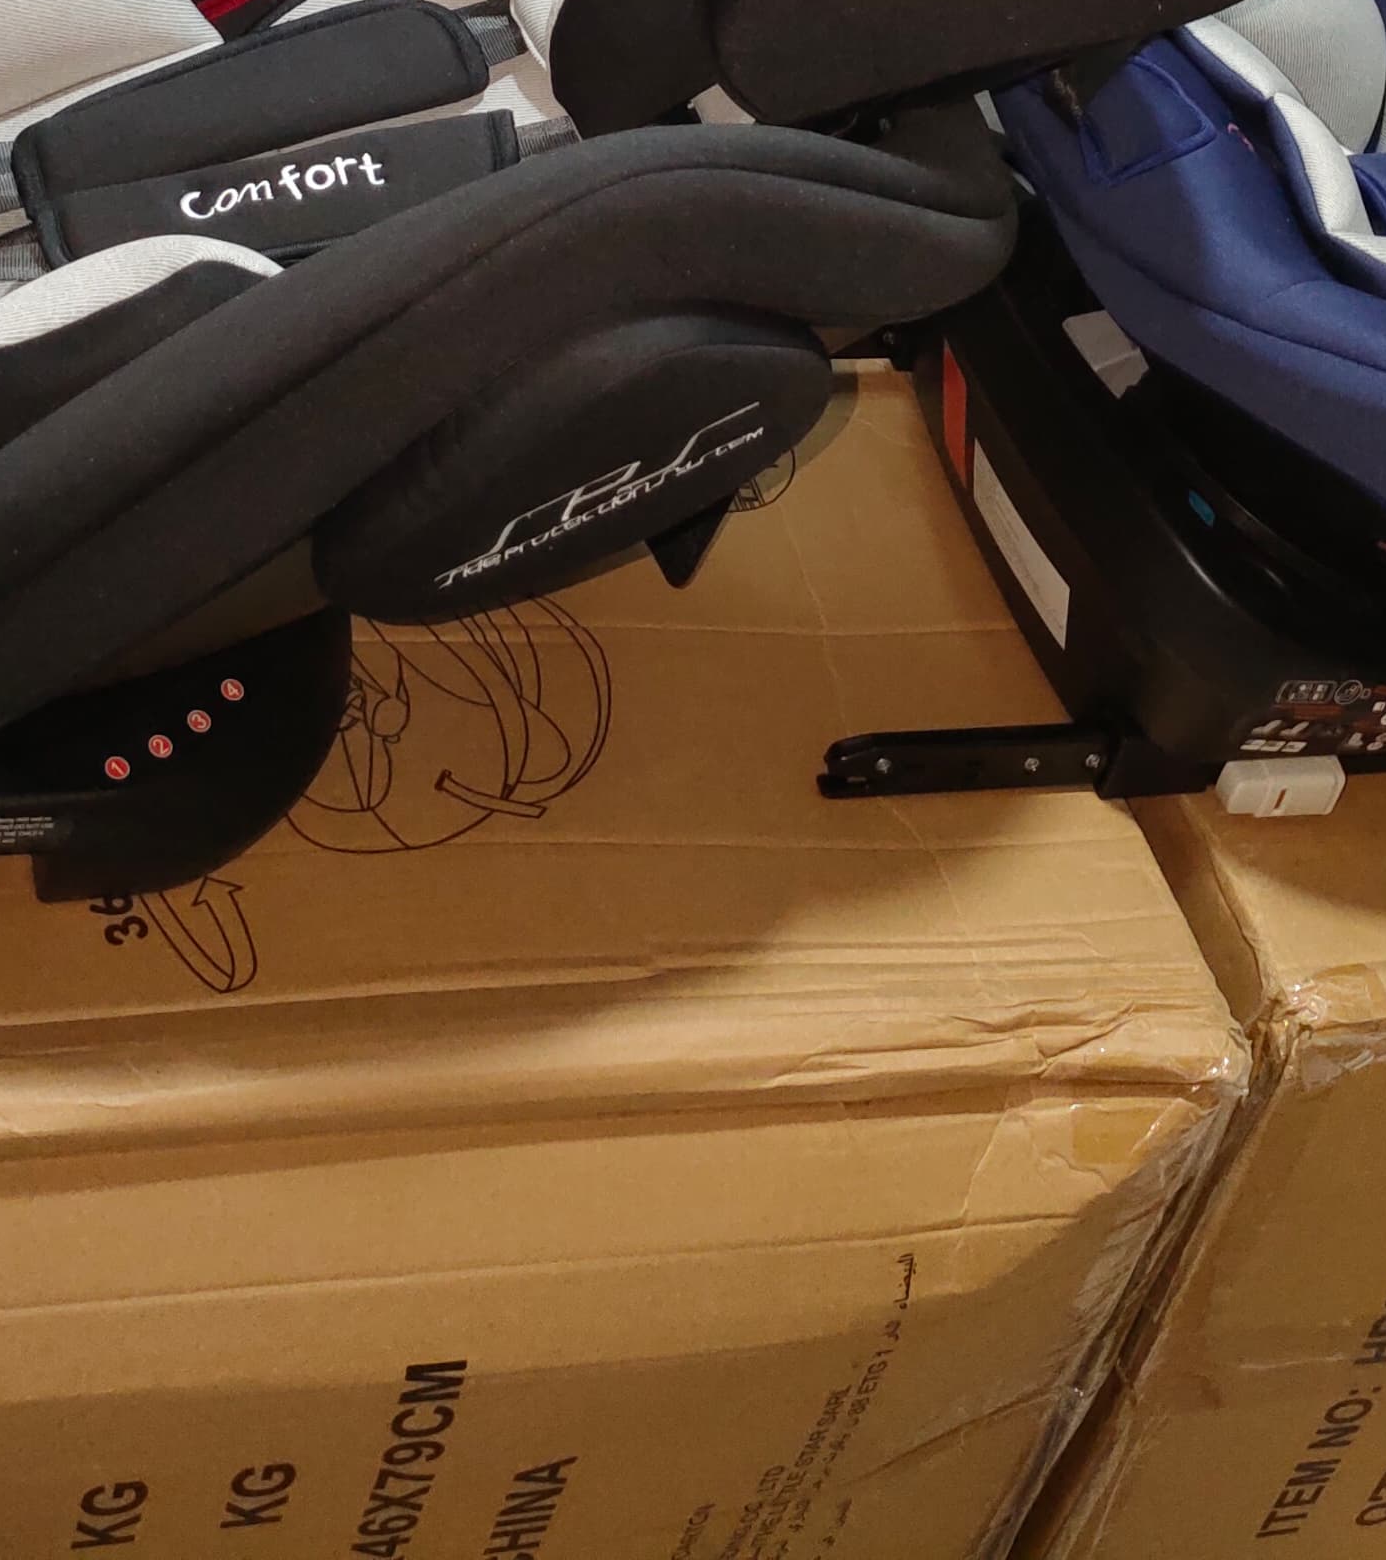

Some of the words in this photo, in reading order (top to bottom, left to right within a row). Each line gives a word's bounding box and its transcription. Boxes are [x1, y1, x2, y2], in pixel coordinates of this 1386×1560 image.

[179, 152, 385, 220] Confort
[219, 1460, 297, 1530] KG
[1255, 1440, 1335, 1539] ITEM
[1321, 1385, 1384, 1453] NO:
[70, 1479, 150, 1551] KG
